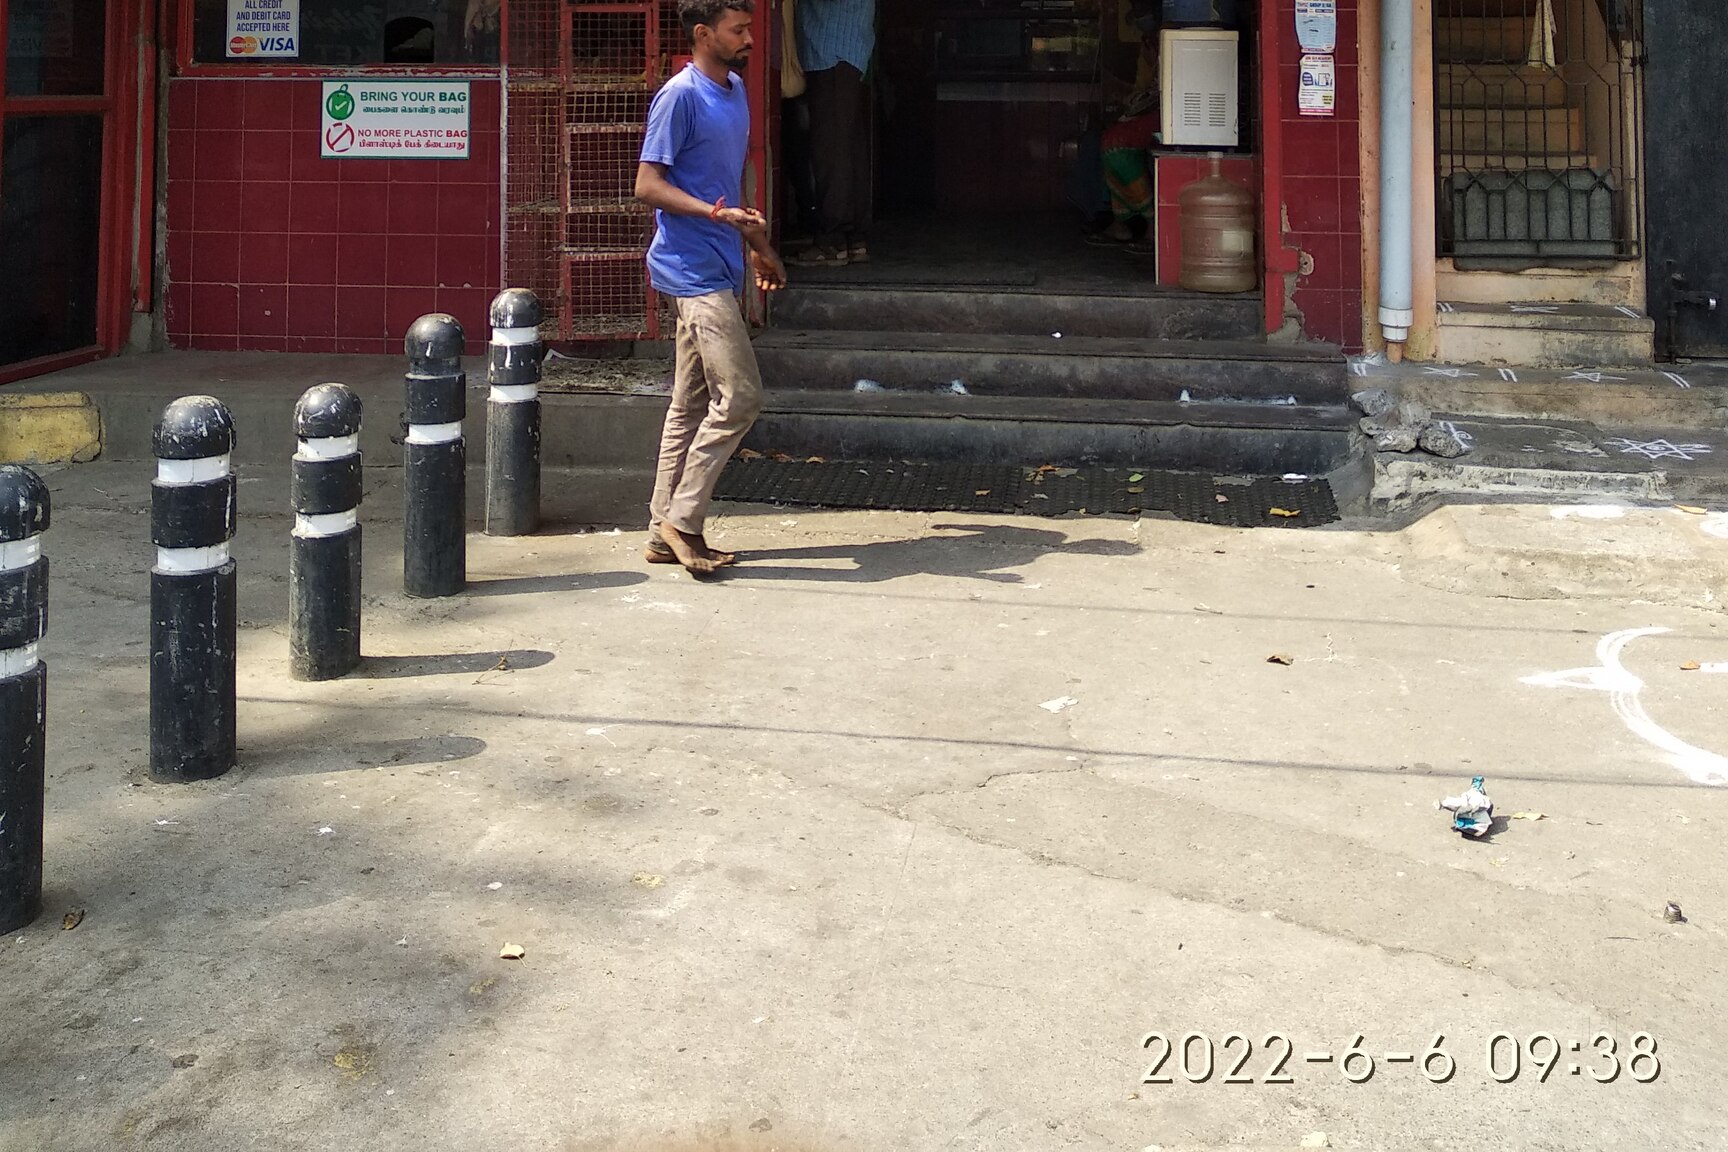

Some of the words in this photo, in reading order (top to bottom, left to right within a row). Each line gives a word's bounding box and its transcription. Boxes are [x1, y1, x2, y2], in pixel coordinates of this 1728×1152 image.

[245, 0, 257, 9] ALL
[259, 0, 283, 8] CREDIT
[236, 11, 250, 20] AND
[252, 11, 271, 20] DEBIT
[272, 11, 291, 20] CARD
[236, 23, 271, 31] ACCEPTED
[272, 23, 290, 31] HERE
[259, 38, 295, 51] VISA
[360, 91, 398, 102] BRING
[401, 91, 435, 102] YOUR
[439, 91, 467, 102] BAG
[357, 129, 372, 138] NO
[374, 129, 401, 138] MORE
[404, 129, 443, 137] PLASTIC
[446, 129, 468, 138] BAG
